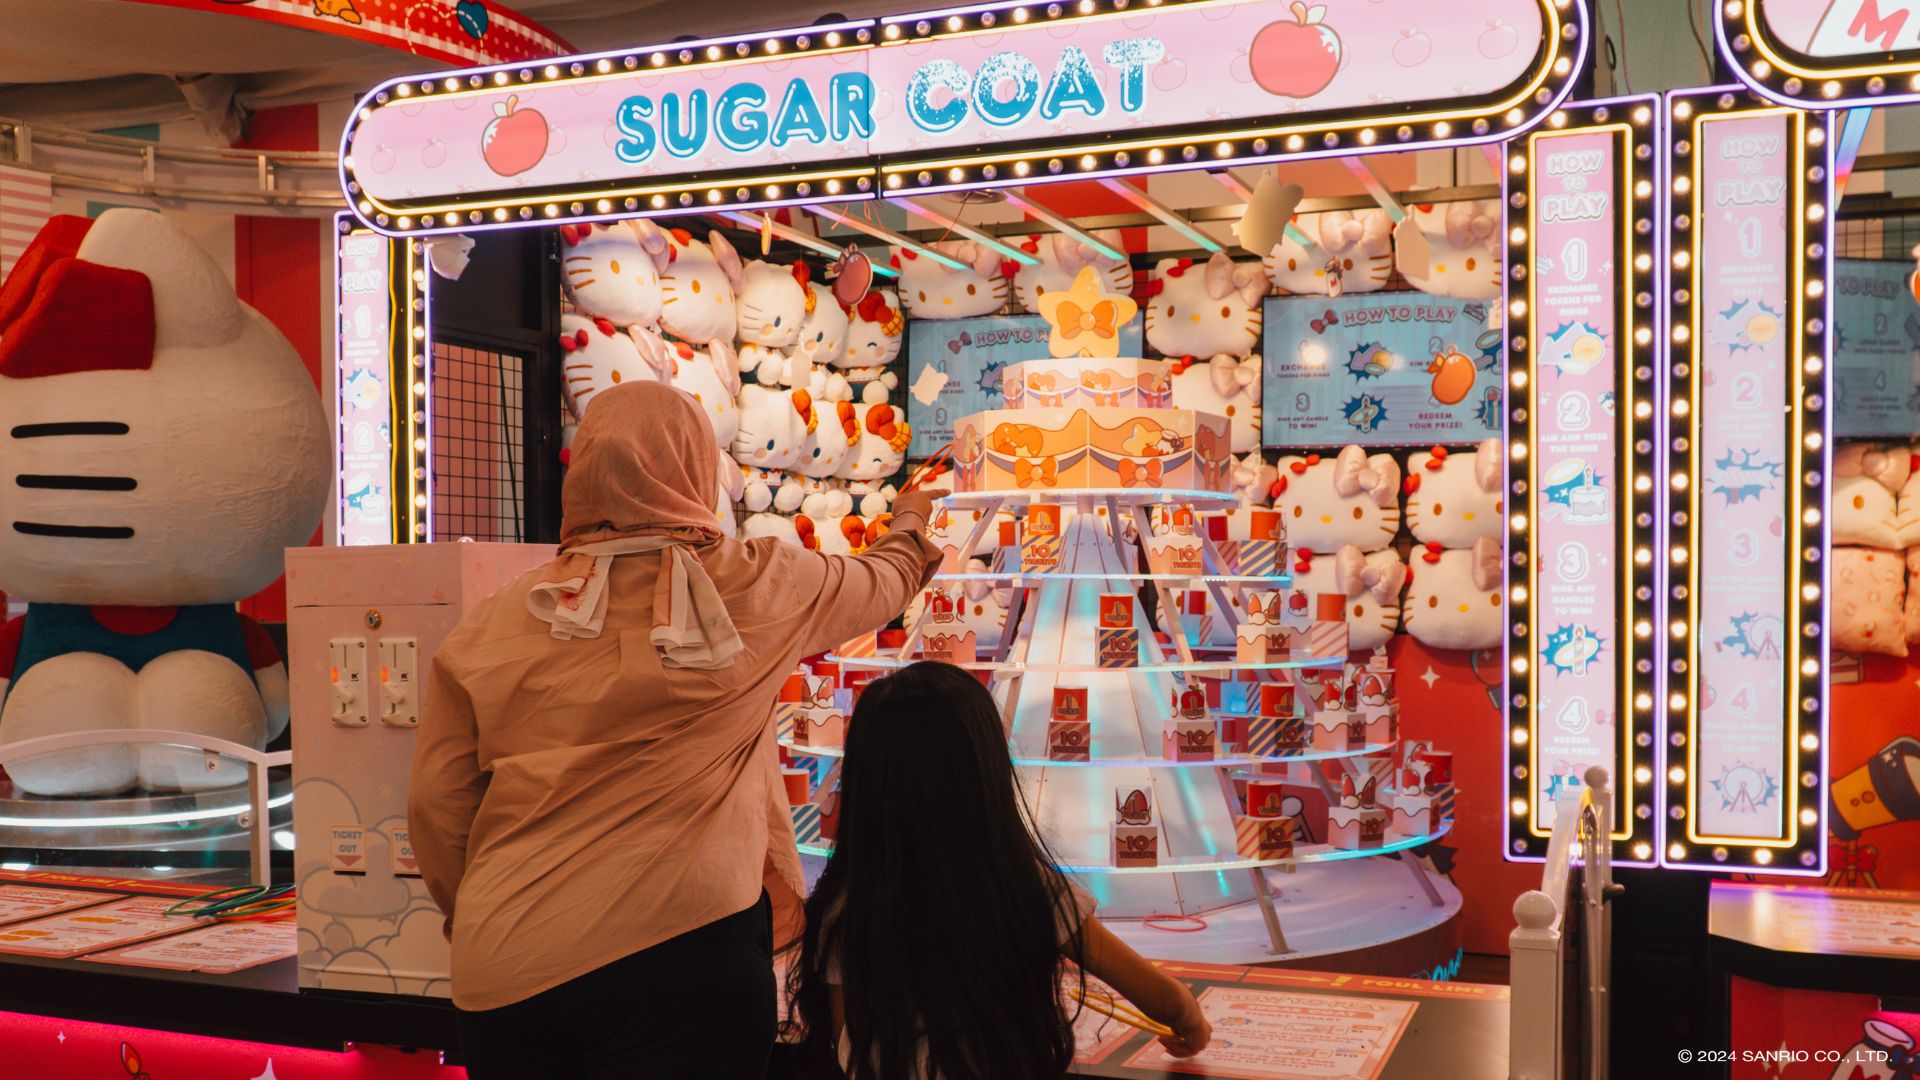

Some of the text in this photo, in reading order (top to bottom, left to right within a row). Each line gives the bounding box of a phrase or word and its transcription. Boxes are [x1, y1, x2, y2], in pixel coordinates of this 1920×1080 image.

[614, 37, 1164, 165] SUGAR COAT
[1722, 133, 1781, 160] HOW
[1547, 150, 1603, 175] HOW
[1564, 176, 1587, 192] TO
[1715, 176, 1785, 206] PLAY
[1542, 192, 1608, 223] PLAY
[1739, 217, 1763, 258] 1
[1562, 238, 1587, 281] 1
[1863, 278, 1900, 300] PLAY
[1343, 305, 1457, 326] HOW TO PLAY
[1875, 313, 1887, 335] 2
[976, 329, 1010, 348] HOW
[1013, 327, 1033, 343] TO
[1429, 336, 1443, 355] 2
[1731, 371, 1762, 408] 2
[1874, 370, 1887, 391] 4
[1296, 393, 1310, 411] 3
[1557, 390, 1591, 431] 2
[935, 408, 948, 425] 3
[1435, 421, 1463, 429] PRIZE!
[353, 421, 374, 453] 2
[1541, 432, 1608, 442] AIM AND TOSS
[1550, 445, 1568, 453] THE
[1030, 544, 1050, 557] 10
[1178, 547, 1198, 561] 10
[1730, 529, 1759, 566] 3
[1558, 541, 1590, 583] 3
[1576, 584, 1596, 593] ANY
[1554, 607, 1568, 615] TO
[929, 637, 946, 650] 10
[1109, 637, 1131, 651] 10
[1271, 633, 1286, 647] 10
[1728, 683, 1757, 718] 4
[1556, 696, 1590, 734] 4
[1060, 731, 1082, 745] 10
[1186, 730, 1208, 745] 10
[1281, 727, 1299, 741] 10
[333, 831, 362, 839] TICKET
[394, 833, 408, 841] TIC
[1126, 835, 1149, 850] 10
[1266, 827, 1285, 841] 10
[1362, 979, 1486, 994] FOUL LINE
